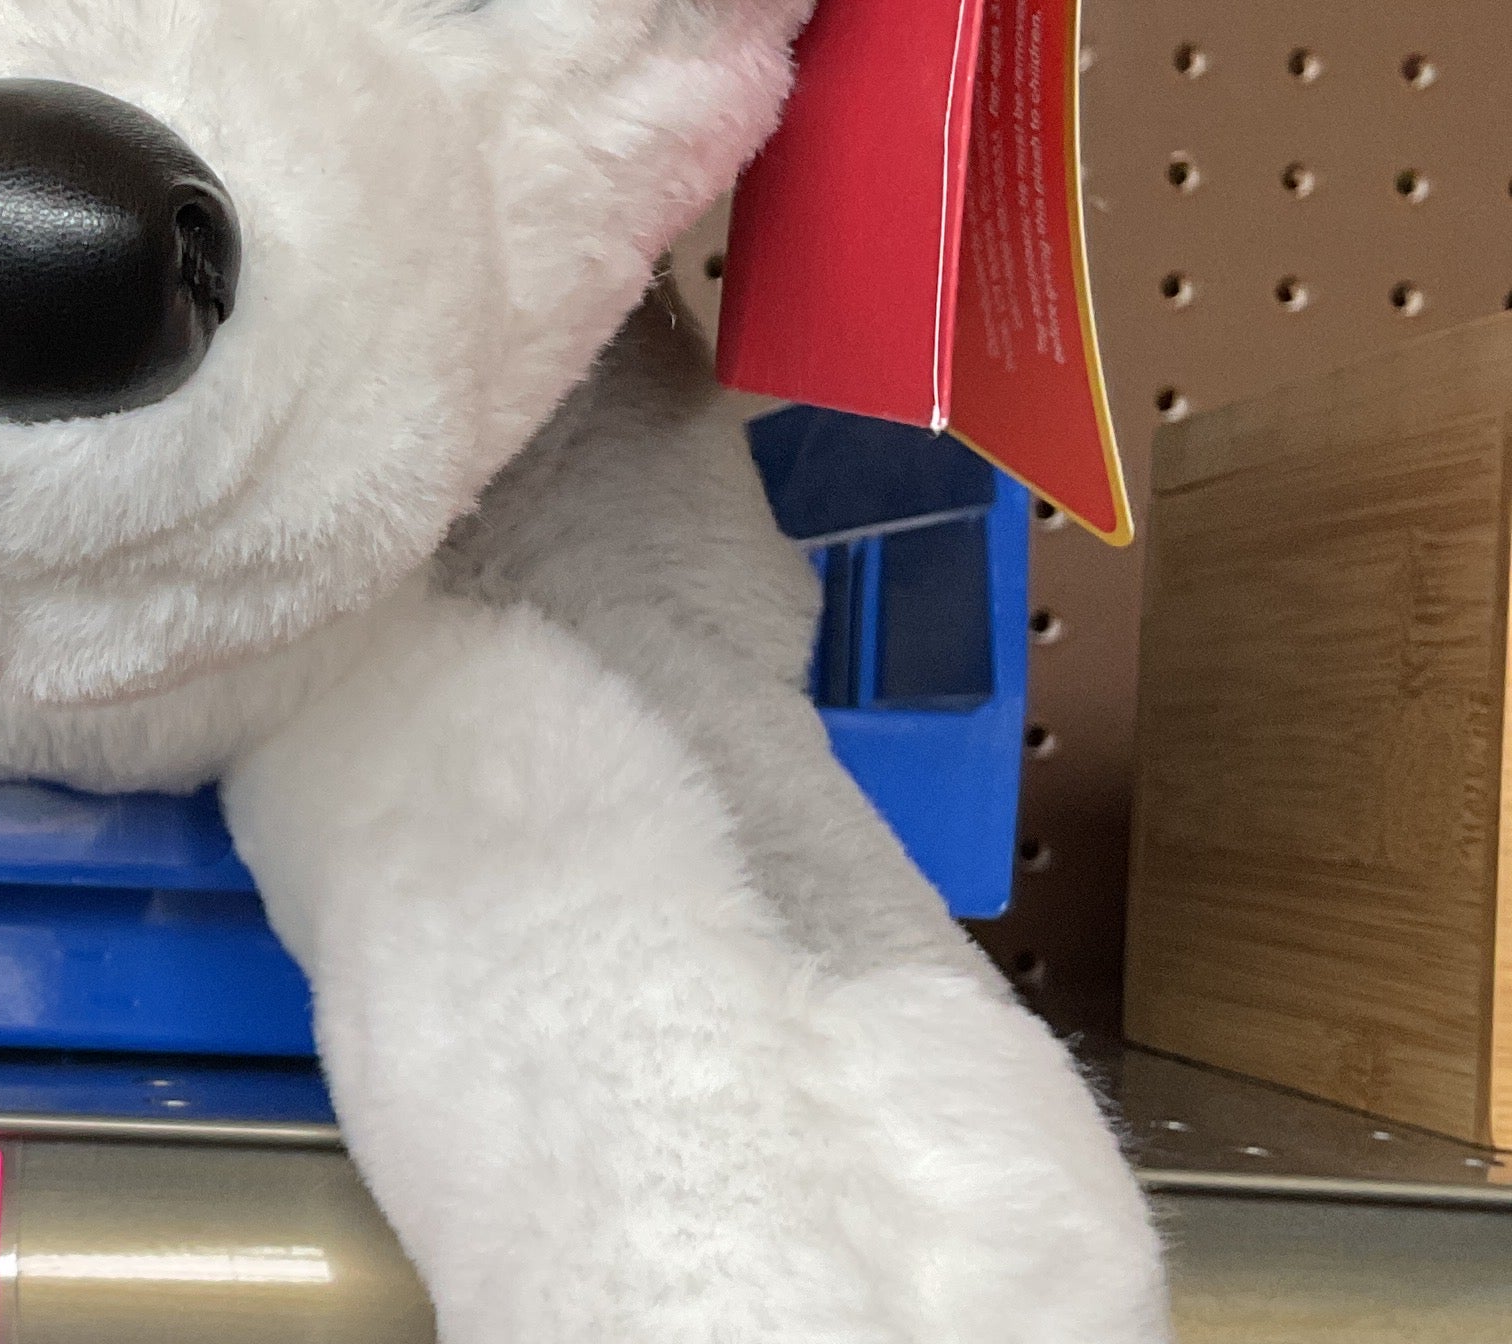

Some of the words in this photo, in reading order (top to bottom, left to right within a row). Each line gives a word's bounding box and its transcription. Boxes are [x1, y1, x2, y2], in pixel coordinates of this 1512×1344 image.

[1012, 93, 1023, 120] be
[1029, 108, 1040, 131] to
[1015, 124, 1026, 178] must
[1030, 136, 1043, 195] plush
[1034, 198, 1046, 235] this
